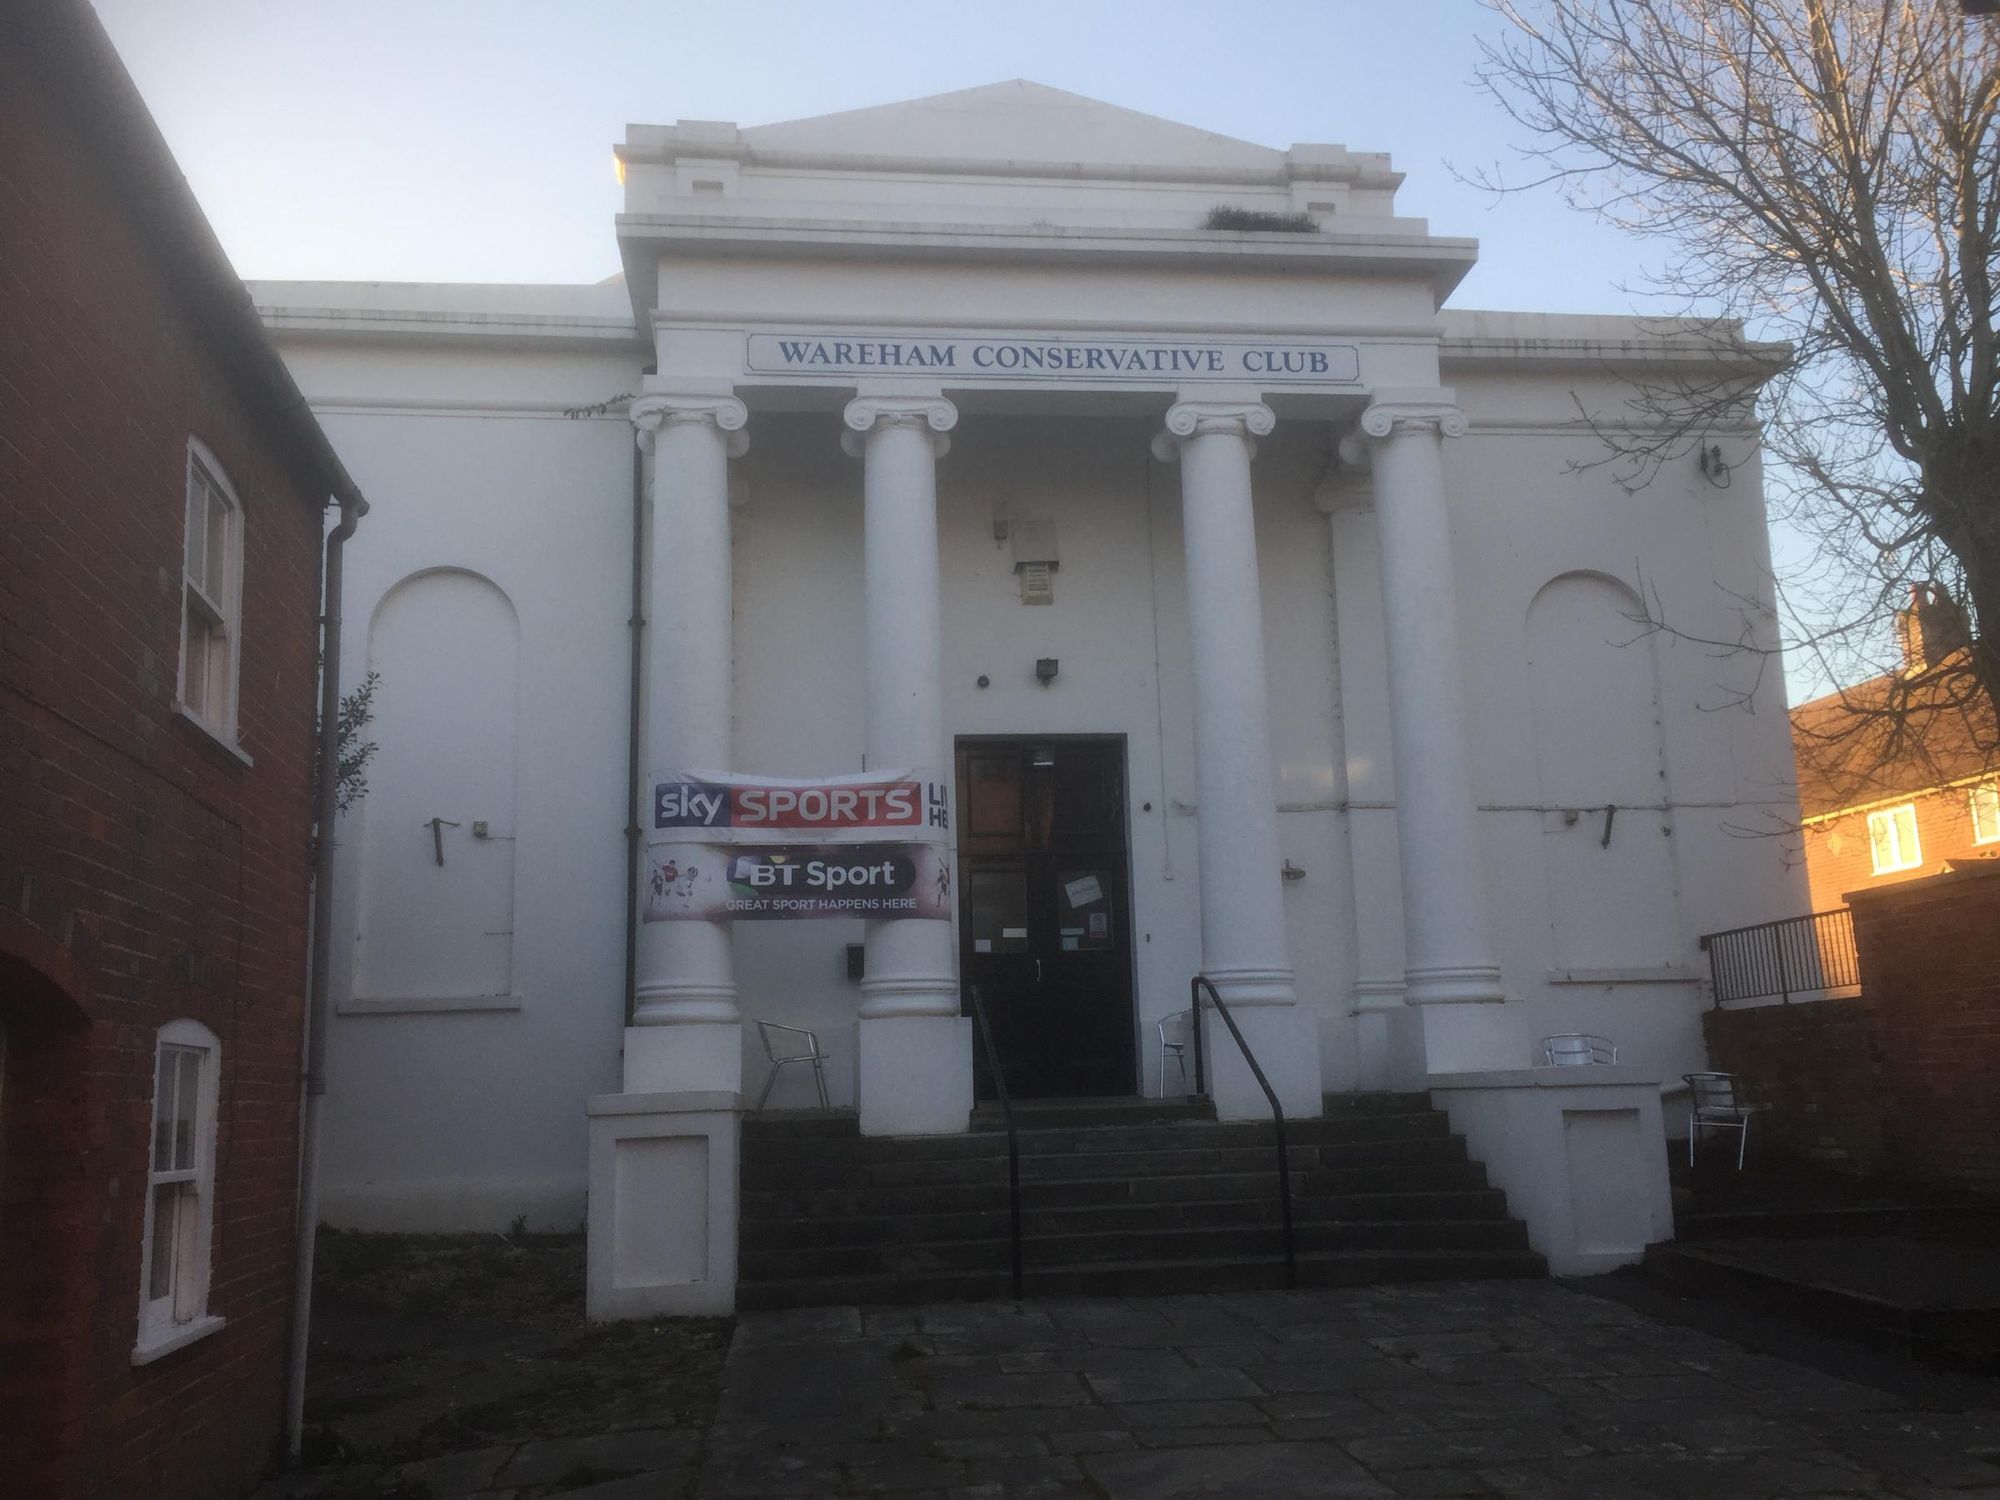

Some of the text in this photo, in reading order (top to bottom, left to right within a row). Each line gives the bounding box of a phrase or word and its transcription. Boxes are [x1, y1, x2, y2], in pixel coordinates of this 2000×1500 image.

[778, 341, 1329, 373] WAREHAM CONSERVATIVE CLUB
[660, 785, 914, 825] sky SPORTS
[751, 860, 895, 890] BT Sport
[726, 898, 917, 911] GREAT SPORT HAPPENS HERE
